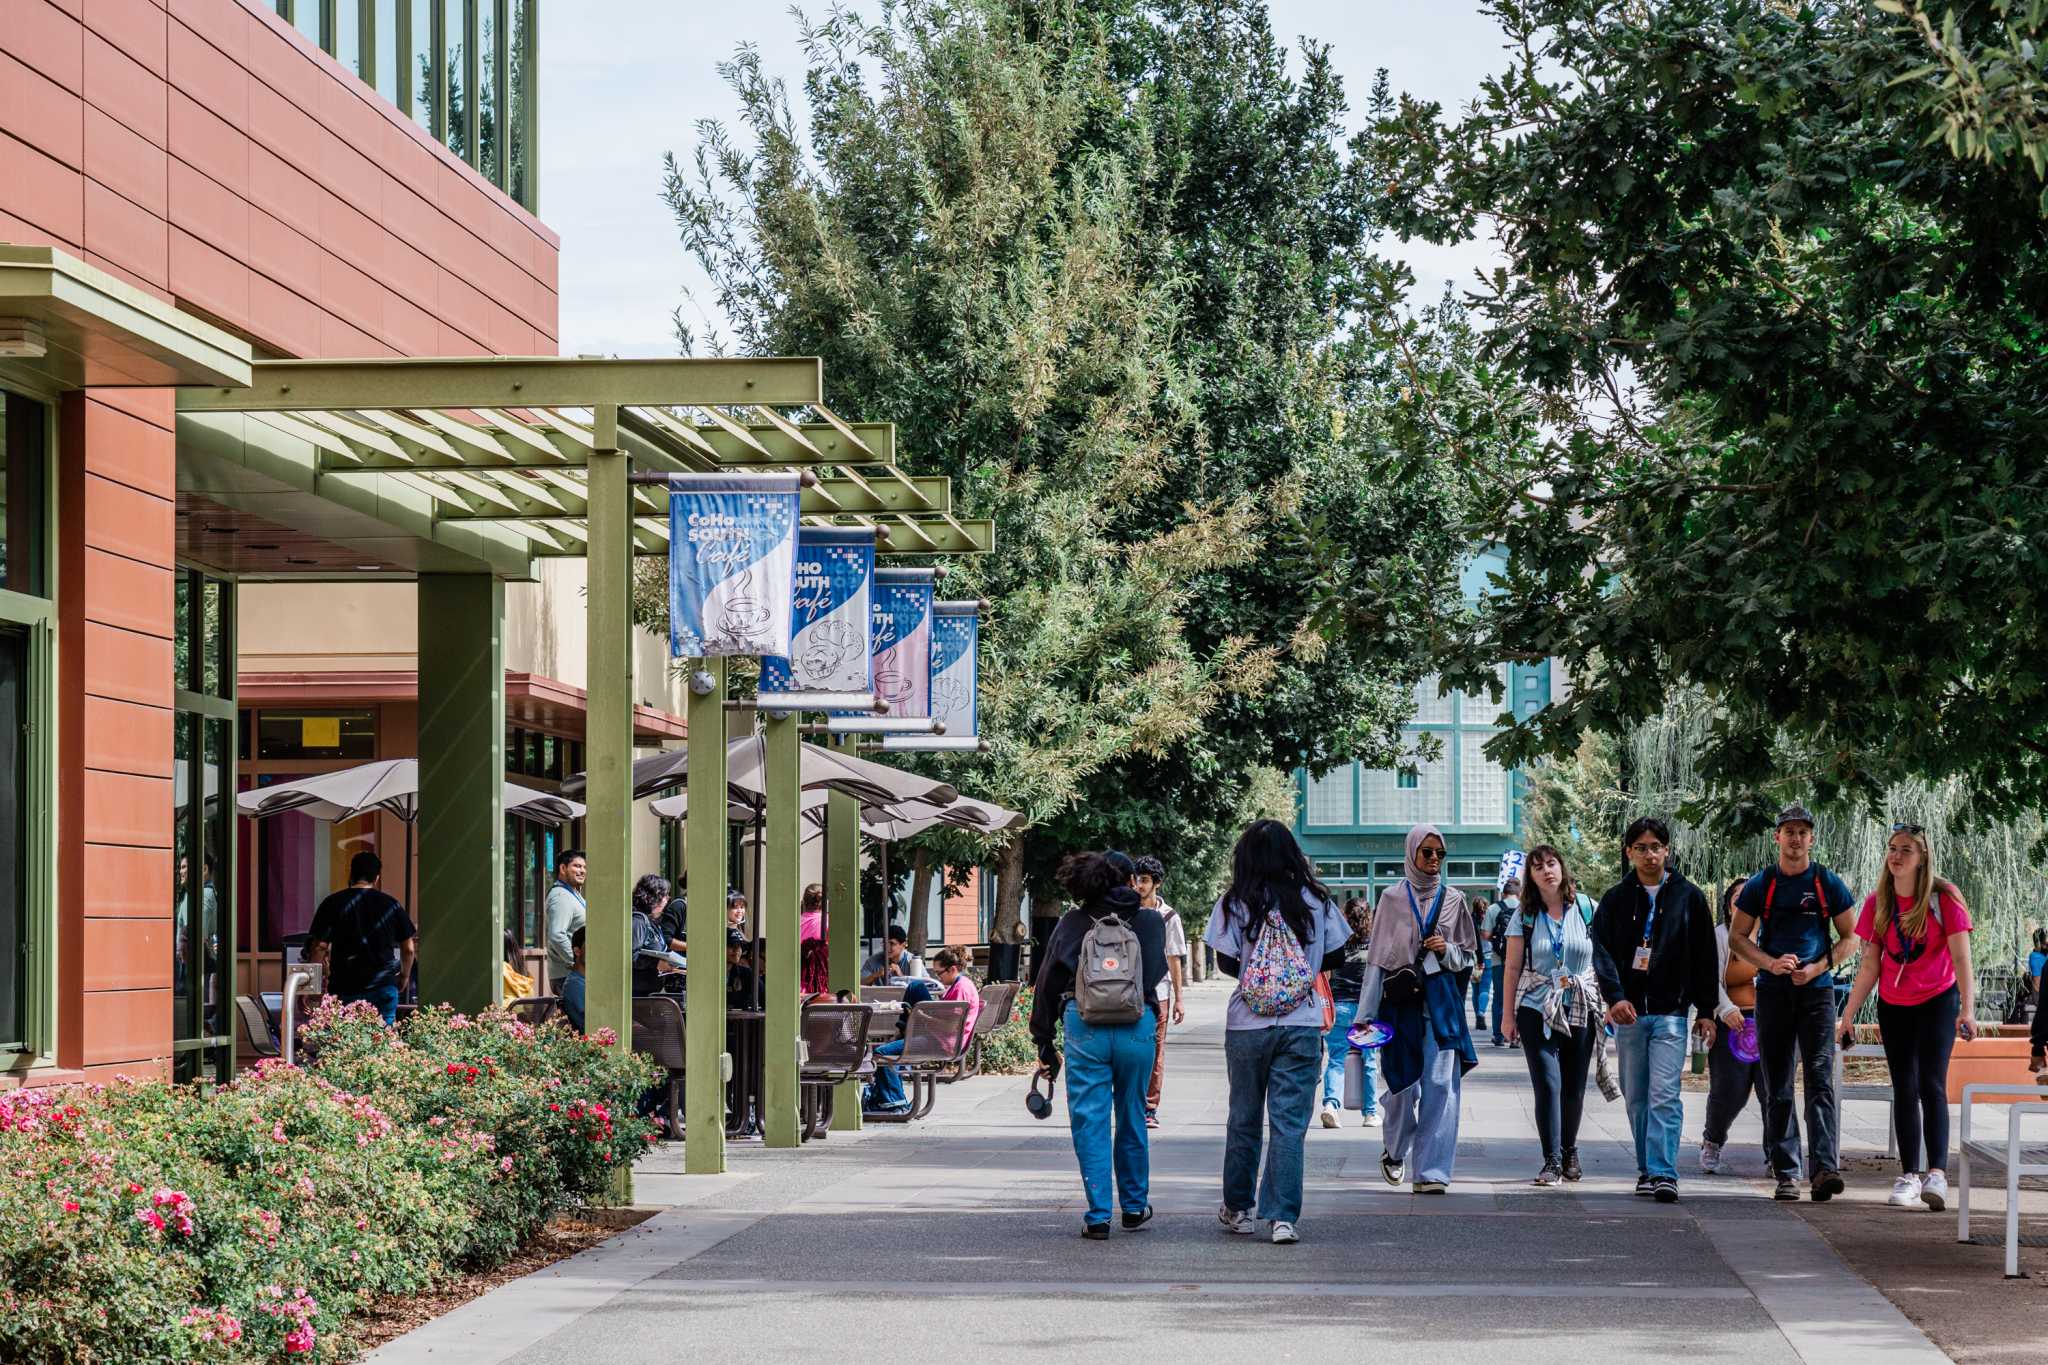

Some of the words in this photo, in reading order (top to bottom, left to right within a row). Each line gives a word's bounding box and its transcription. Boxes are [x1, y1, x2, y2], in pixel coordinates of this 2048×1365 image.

[688, 528, 750, 541] SOUTH
[797, 562, 822, 575] HO
[797, 576, 830, 589] UTH
[793, 587, 832, 622] afé
